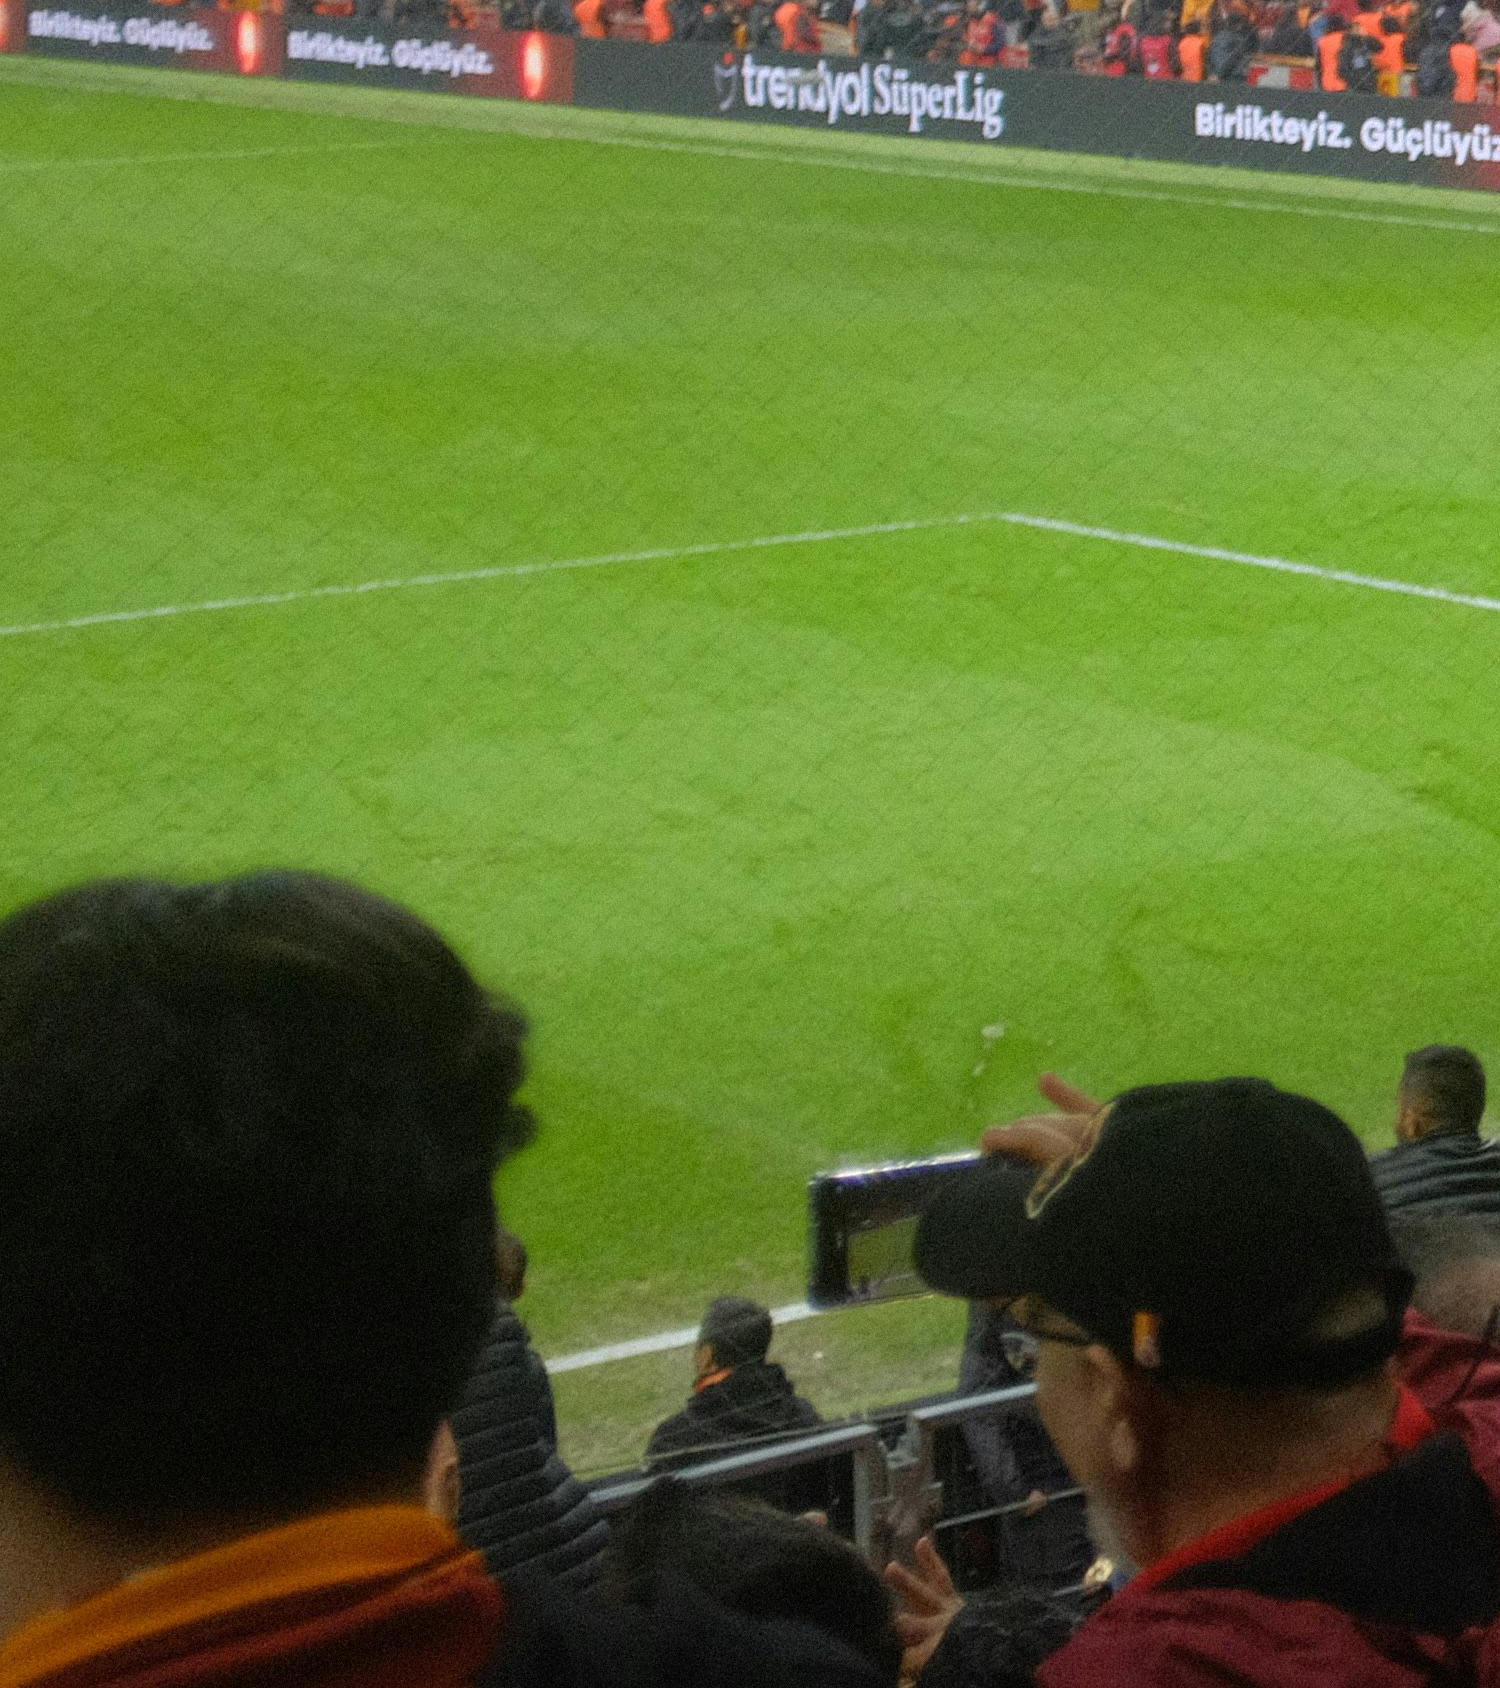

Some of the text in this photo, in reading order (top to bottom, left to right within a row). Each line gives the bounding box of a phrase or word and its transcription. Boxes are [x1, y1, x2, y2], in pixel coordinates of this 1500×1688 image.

[287, 29, 494, 77] Birlikteyiz. Güçlüyüz.
[741, 55, 868, 124] trendyol
[1195, 102, 1351, 152] Birlikteyiz.
